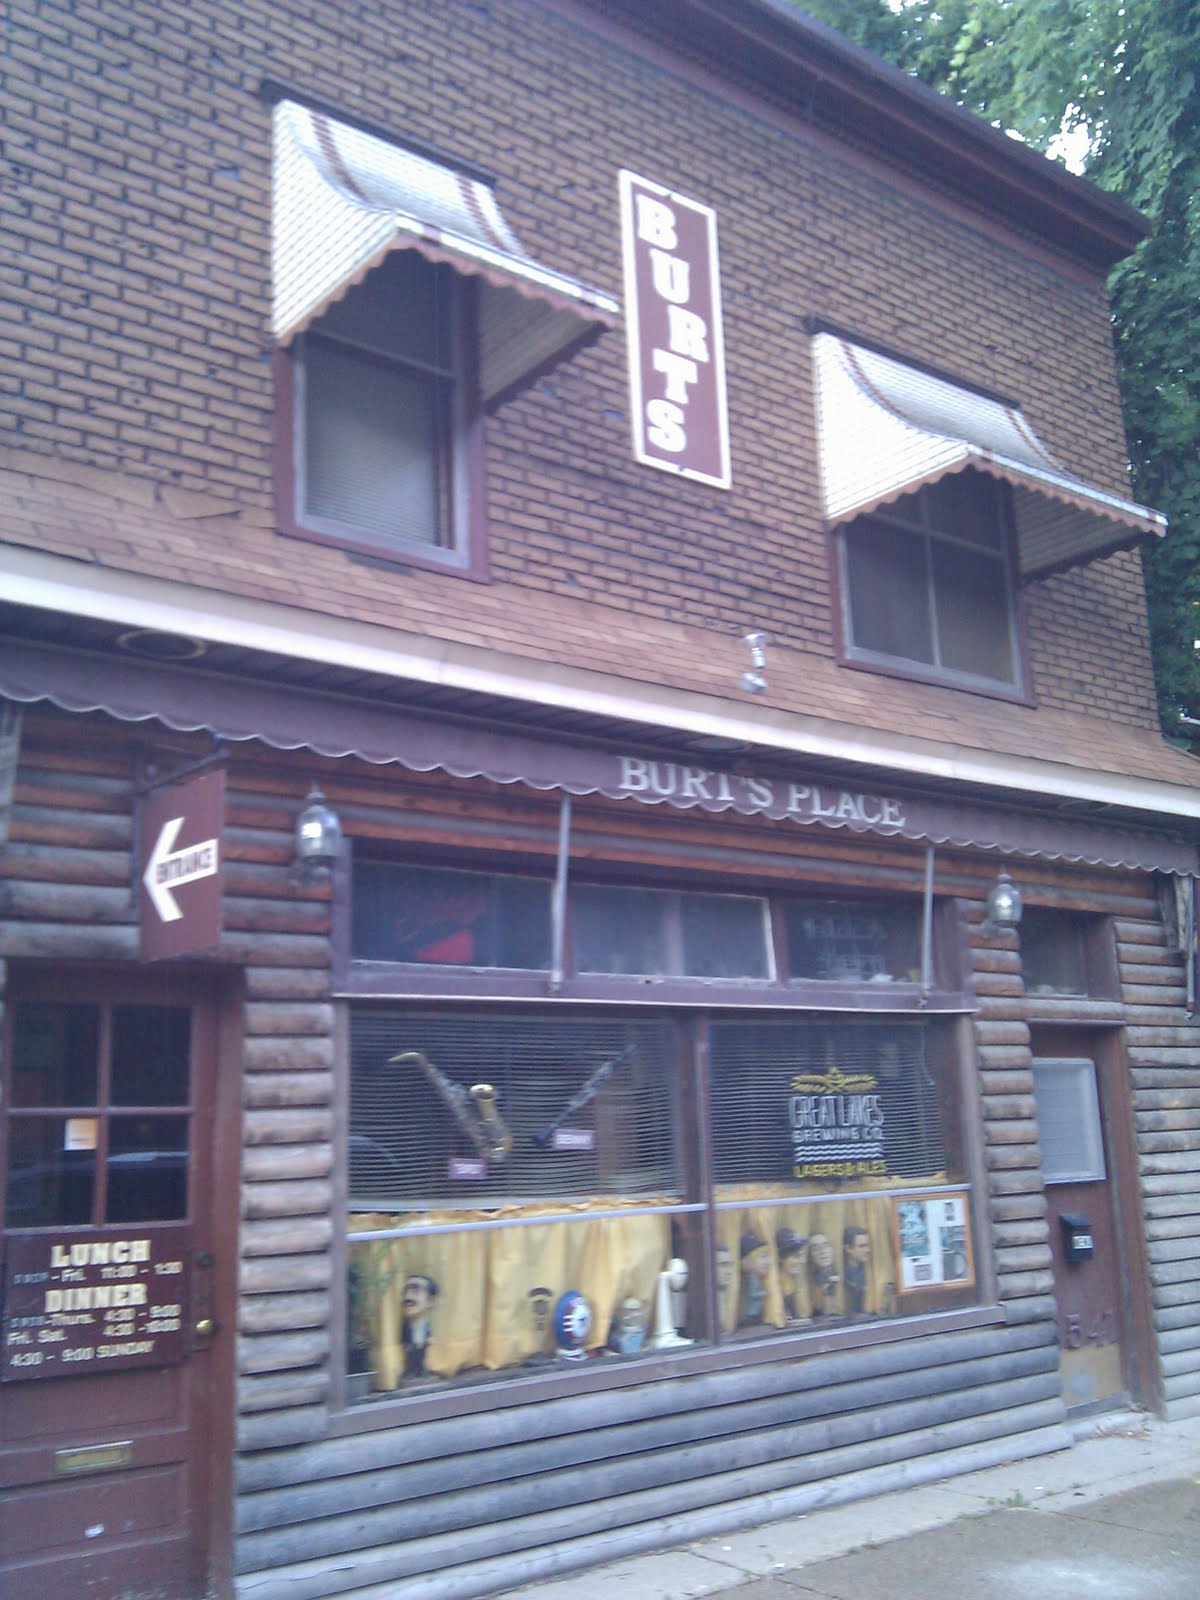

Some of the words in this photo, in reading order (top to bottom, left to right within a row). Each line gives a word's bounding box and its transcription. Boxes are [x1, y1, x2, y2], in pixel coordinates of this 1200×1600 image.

[636, 193, 709, 453] BURTS
[616, 756, 774, 807] BURT'S
[787, 783, 906, 827] PLACE
[788, 1094, 837, 1128] GREAT
[838, 1094, 885, 1127] LAKES
[51, 1239, 151, 1268] LUNCH
[44, 1283, 148, 1313] DINNER
